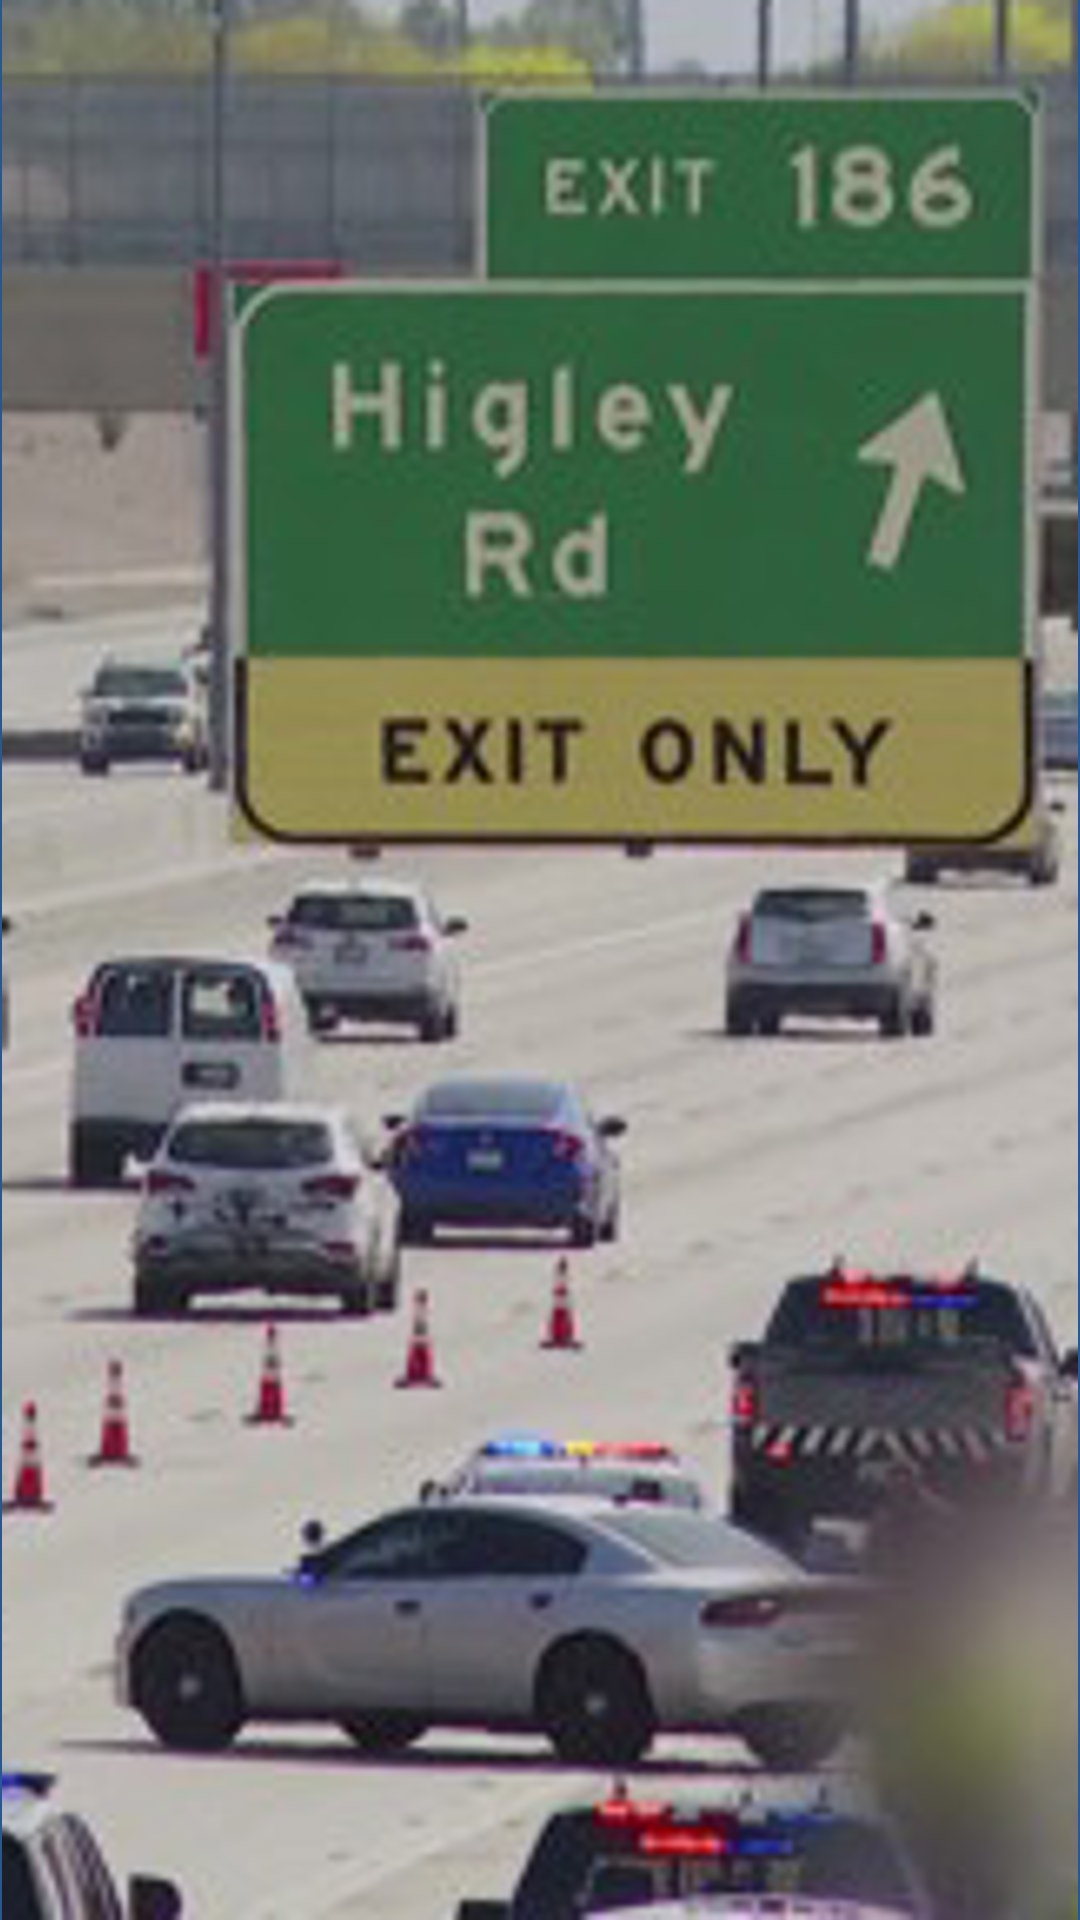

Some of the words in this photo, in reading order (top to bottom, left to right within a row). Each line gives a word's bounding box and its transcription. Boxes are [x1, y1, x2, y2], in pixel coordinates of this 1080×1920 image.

[544, 158, 713, 215] EXIT
[790, 145, 973, 228] 186
[331, 360, 733, 478] Higley
[465, 511, 609, 599] Rd
[380, 718, 584, 785] EXIT
[639, 717, 891, 787] ONLY
